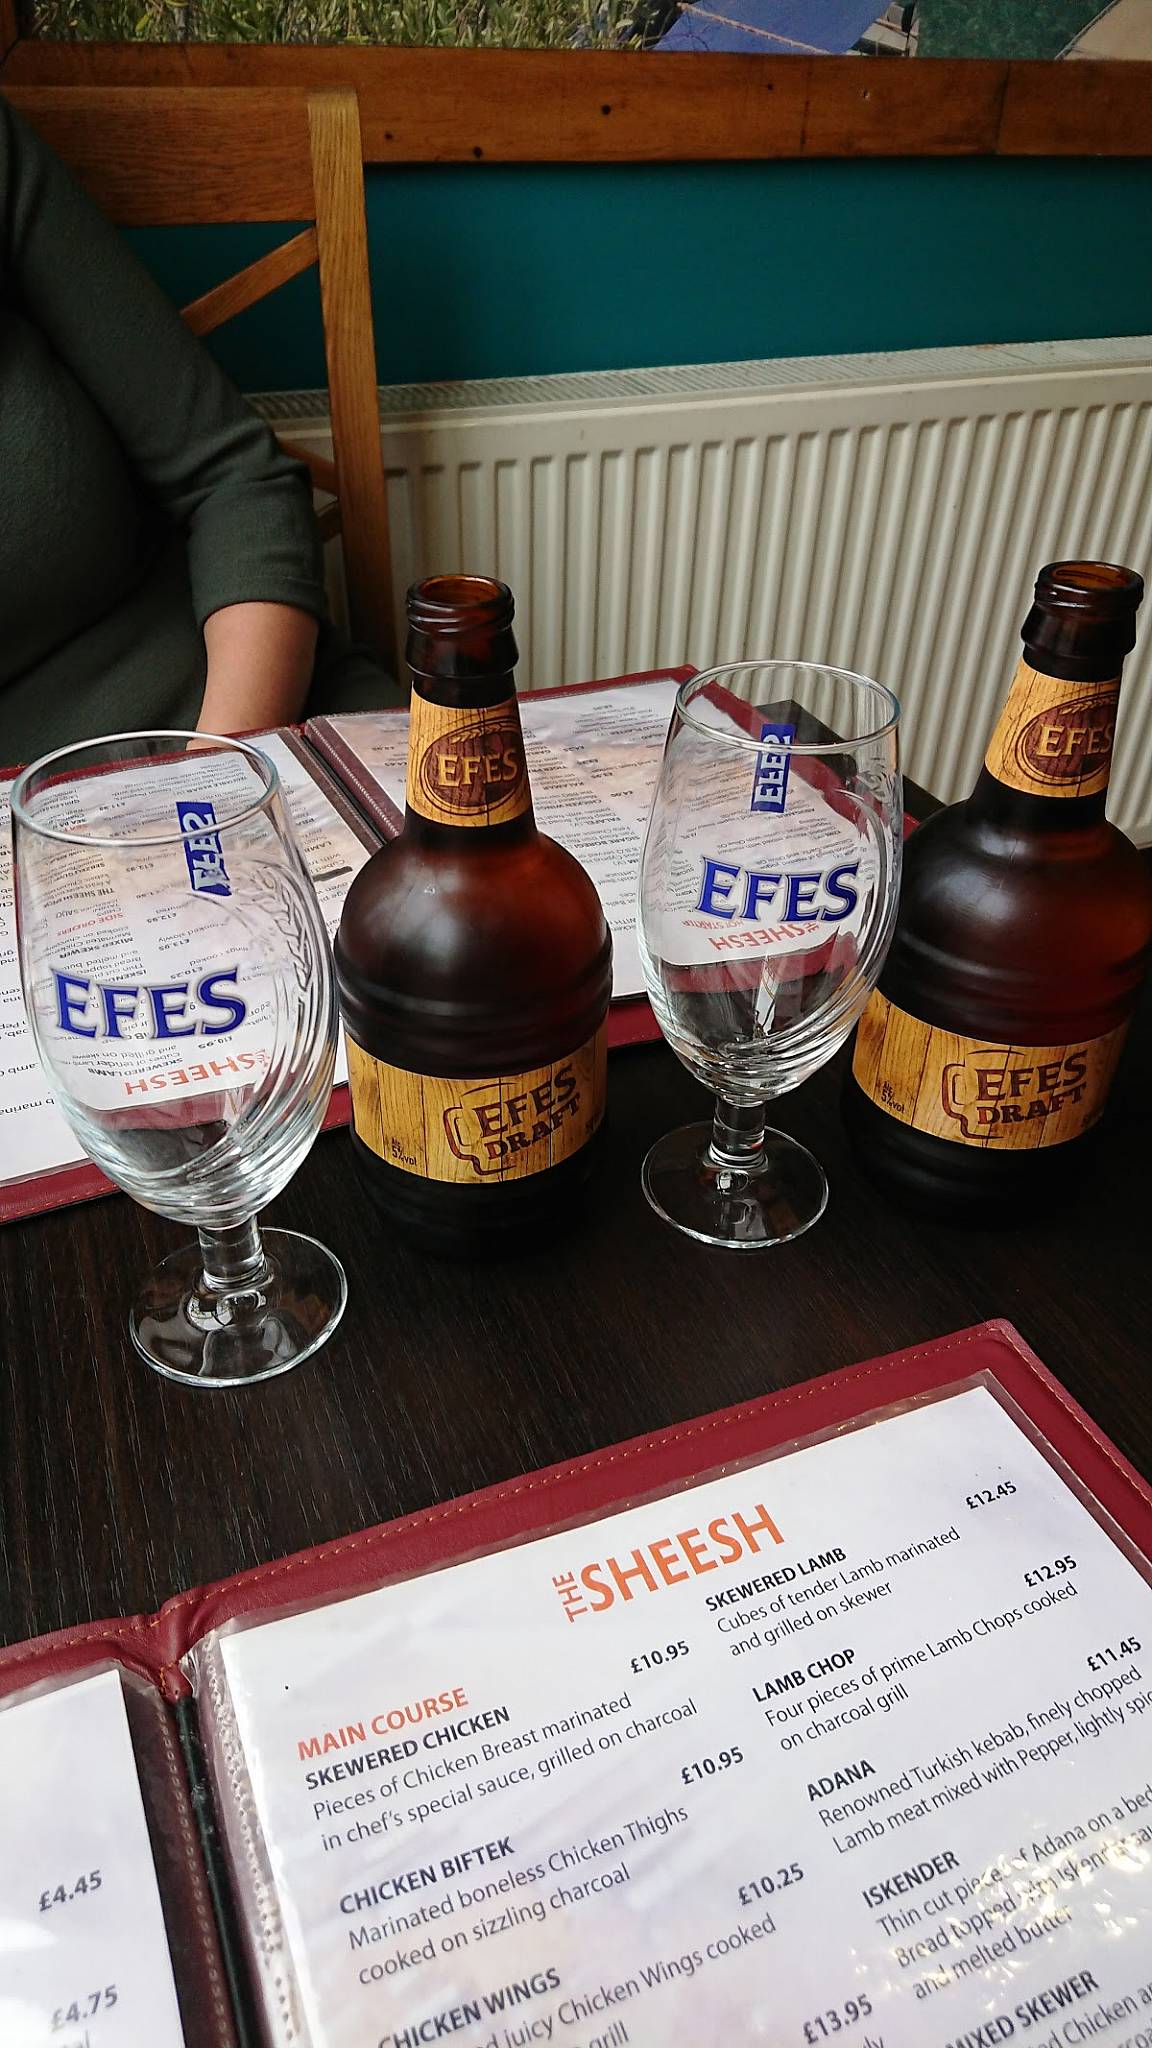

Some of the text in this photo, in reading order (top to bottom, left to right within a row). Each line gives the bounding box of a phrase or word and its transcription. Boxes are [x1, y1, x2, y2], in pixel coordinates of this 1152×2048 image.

[436, 747, 519, 788] EFES
[1035, 723, 1113, 758] EFES
[98, 911, 124, 924] SIDE
[695, 856, 861, 922] EFES
[707, 922, 806, 951] SHEESH
[51, 964, 247, 1041] EFES
[124, 1053, 257, 1095] SHEESH
[471, 1062, 577, 1139] EFES
[975, 1050, 1089, 1102] EFES
[977, 1082, 1087, 1126] DRAFT
[483, 1092, 580, 1160] DRAFT
[965, 1480, 1018, 1510] £12.45
[551, 1502, 785, 1623] THE SHEESH
[704, 1547, 848, 1613] SKEWERED LAMB
[716, 1525, 961, 1634] Cubes of tender Lamb marinated
[1023, 1554, 1078, 1588] £12.95
[729, 1580, 894, 1657] and grilled on skewer
[630, 1639, 690, 1675] £10.95
[751, 1648, 856, 1704] LAMB CHOP
[764, 1580, 1079, 1727] Four pieces of prime Lamb Chops cooked
[1086, 1636, 1142, 1673] £11.45
[296, 1687, 469, 1761] MAIN COURSE
[304, 1706, 511, 1791] SKEWERED CHICKEN
[779, 1683, 909, 1753] on charcoal grill
[818, 1664, 1143, 1828] Renowned Turkish kebab, finely chopped
[312, 1691, 633, 1821] Pieces of Chicken Breast marinated
[320, 1697, 699, 1852] in chef's special sauce, grilled on charcoal
[680, 1746, 745, 1785] £10.95
[806, 1757, 878, 1802] ADANA
[831, 1819, 885, 1855] Lamb
[885, 1797, 932, 1830] meat
[930, 1771, 983, 1806] mixed
[981, 1748, 1021, 1784] with
[1016, 1730, 1080, 1766] Pepper,
[1073, 1705, 1126, 1738] lightly
[38, 1869, 102, 1912] £4.45
[339, 1835, 516, 1915] CHICKEN BIFTEK
[348, 1806, 689, 1951] Marinated boneless Chicken Thighs
[737, 1862, 806, 1907] £10.25
[861, 1849, 961, 1910] ISKENDER
[876, 1907, 922, 1938] Thin
[923, 1889, 955, 1918] cut
[1031, 1823, 1087, 1862] Adana
[1087, 1813, 1113, 1833] on
[1111, 1806, 1125, 1820] a
[358, 1861, 631, 1985] cooked on sizzling charcoal
[894, 1891, 1018, 1969] Bread topped
[481, 1966, 561, 2015] WINGS
[557, 1977, 641, 2025] Chicken
[639, 1948, 704, 1990] Wings
[706, 1911, 777, 1961] cooked
[912, 1964, 952, 2000] and
[950, 1931, 1018, 1980] melted
[50, 1983, 119, 2033] £4.75
[802, 1993, 873, 2045] £13.95
[1014, 1969, 1100, 2029] SKEWER
[1062, 1994, 1139, 2045] Chicken
